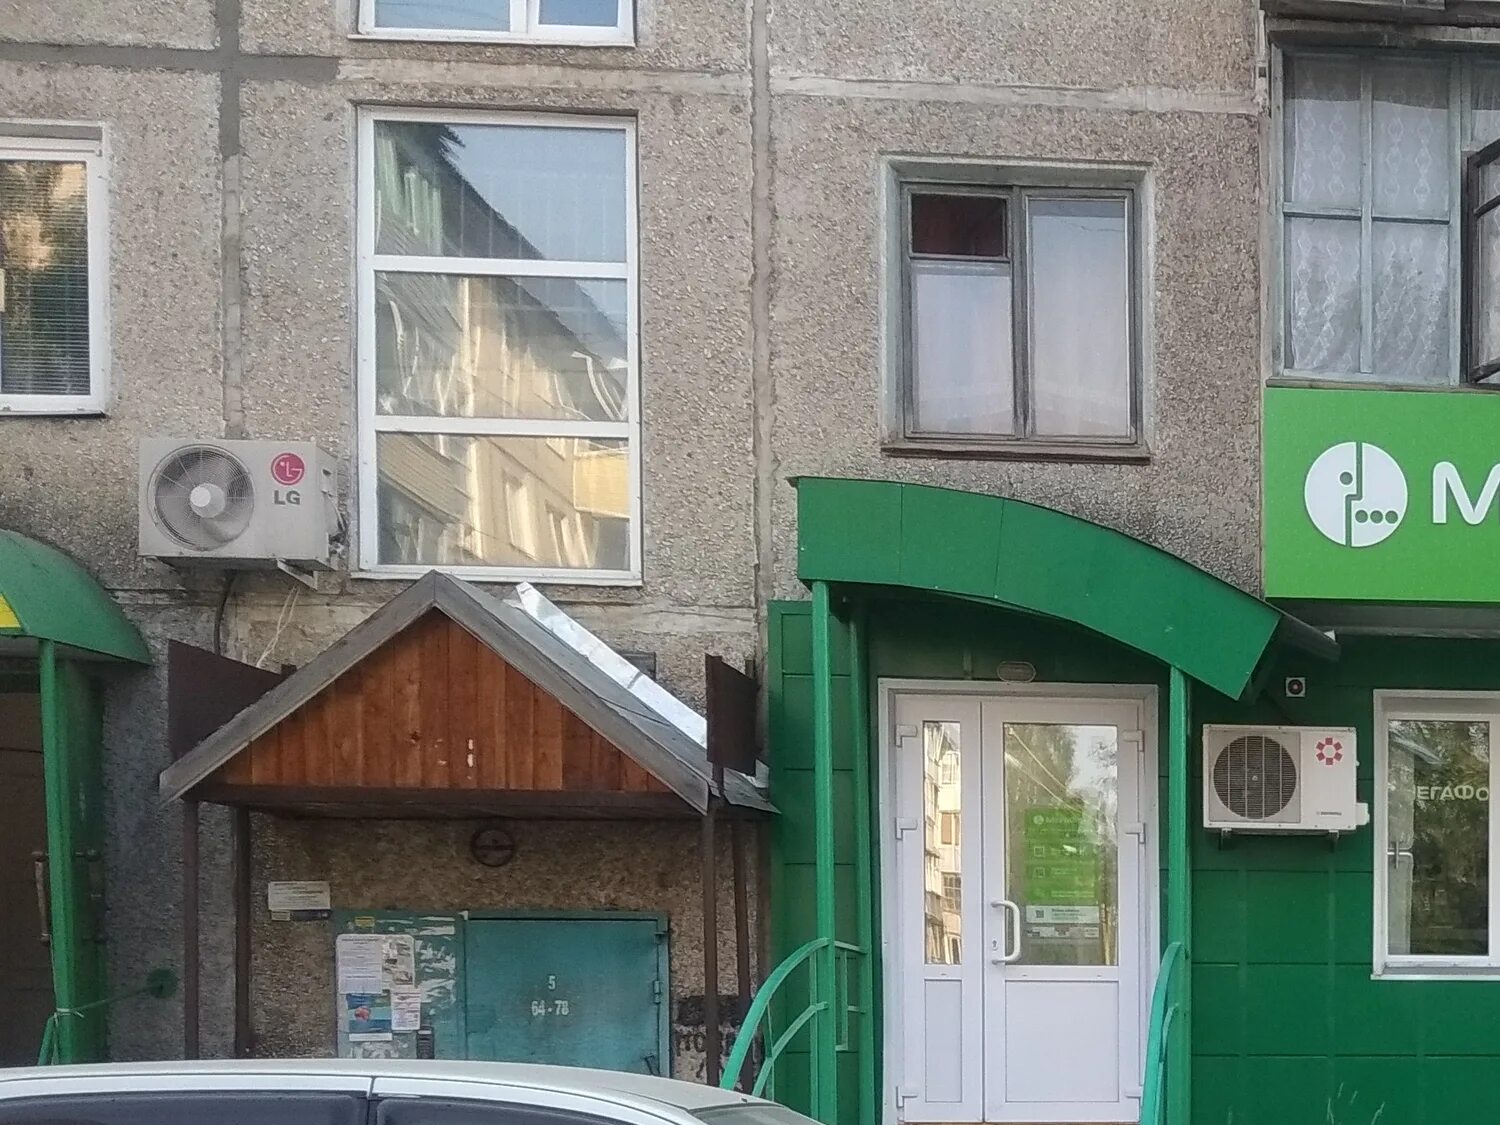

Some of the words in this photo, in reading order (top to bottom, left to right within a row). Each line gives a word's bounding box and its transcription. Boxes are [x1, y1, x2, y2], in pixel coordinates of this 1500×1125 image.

[273, 490, 301, 505] LG
[1413, 784, 1489, 802] ЕГАФО
[548, 975, 556, 990] 5
